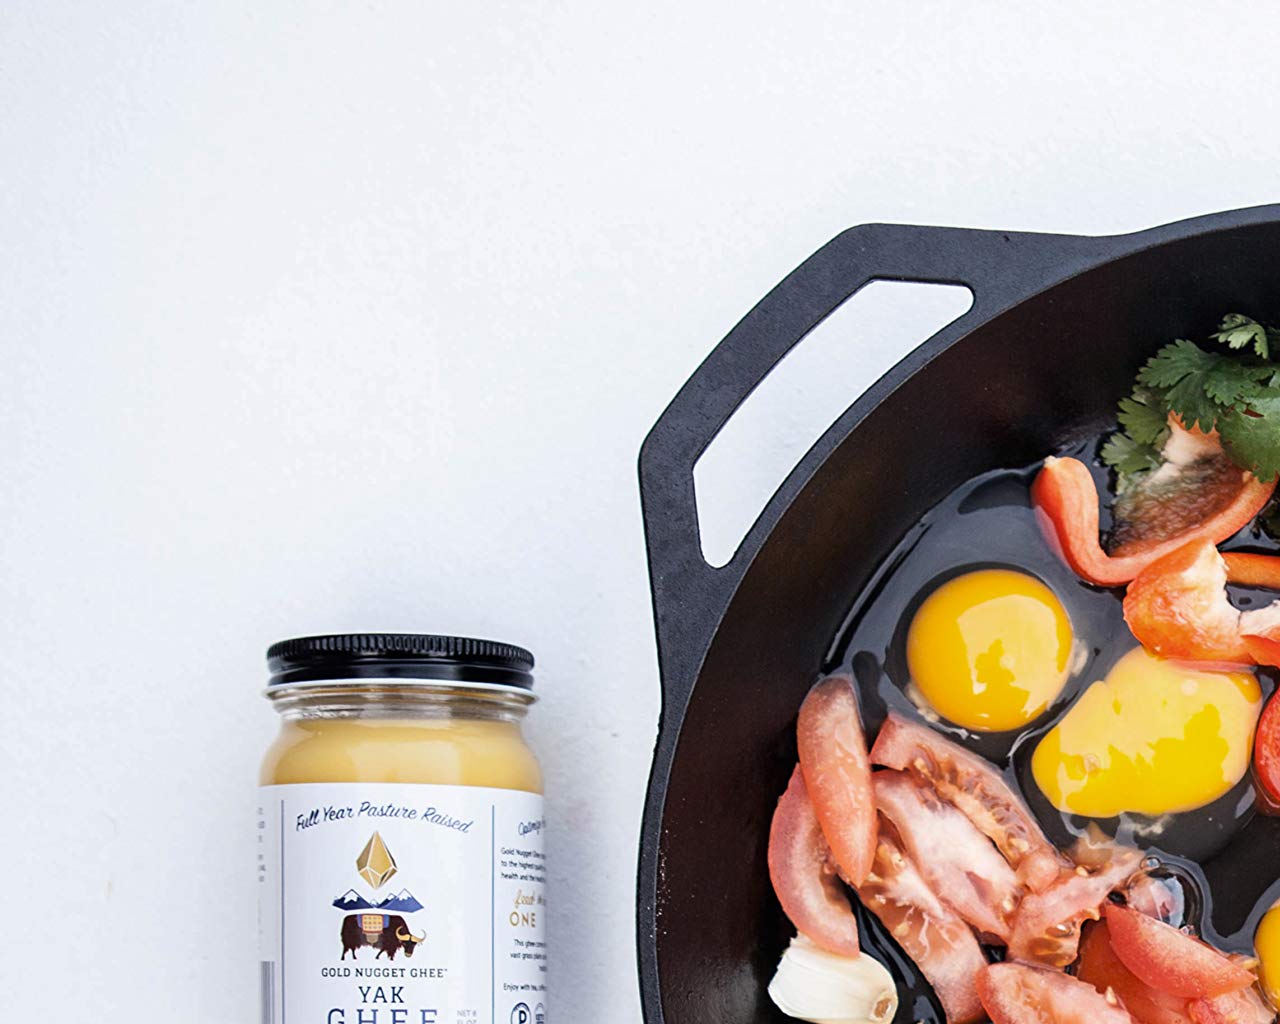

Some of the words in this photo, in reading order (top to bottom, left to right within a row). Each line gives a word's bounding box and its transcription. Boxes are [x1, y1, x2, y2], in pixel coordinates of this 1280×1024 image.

[296, 808, 319, 832] Full
[322, 805, 354, 822] Year
[357, 801, 418, 819] Pasture
[421, 807, 474, 833] Raised
[509, 911, 536, 928] ONE
[321, 968, 350, 978] GOLD
[355, 968, 406, 978] NUGGET
[358, 986, 404, 1003] YAK
[503, 983, 518, 992] Enjoy
